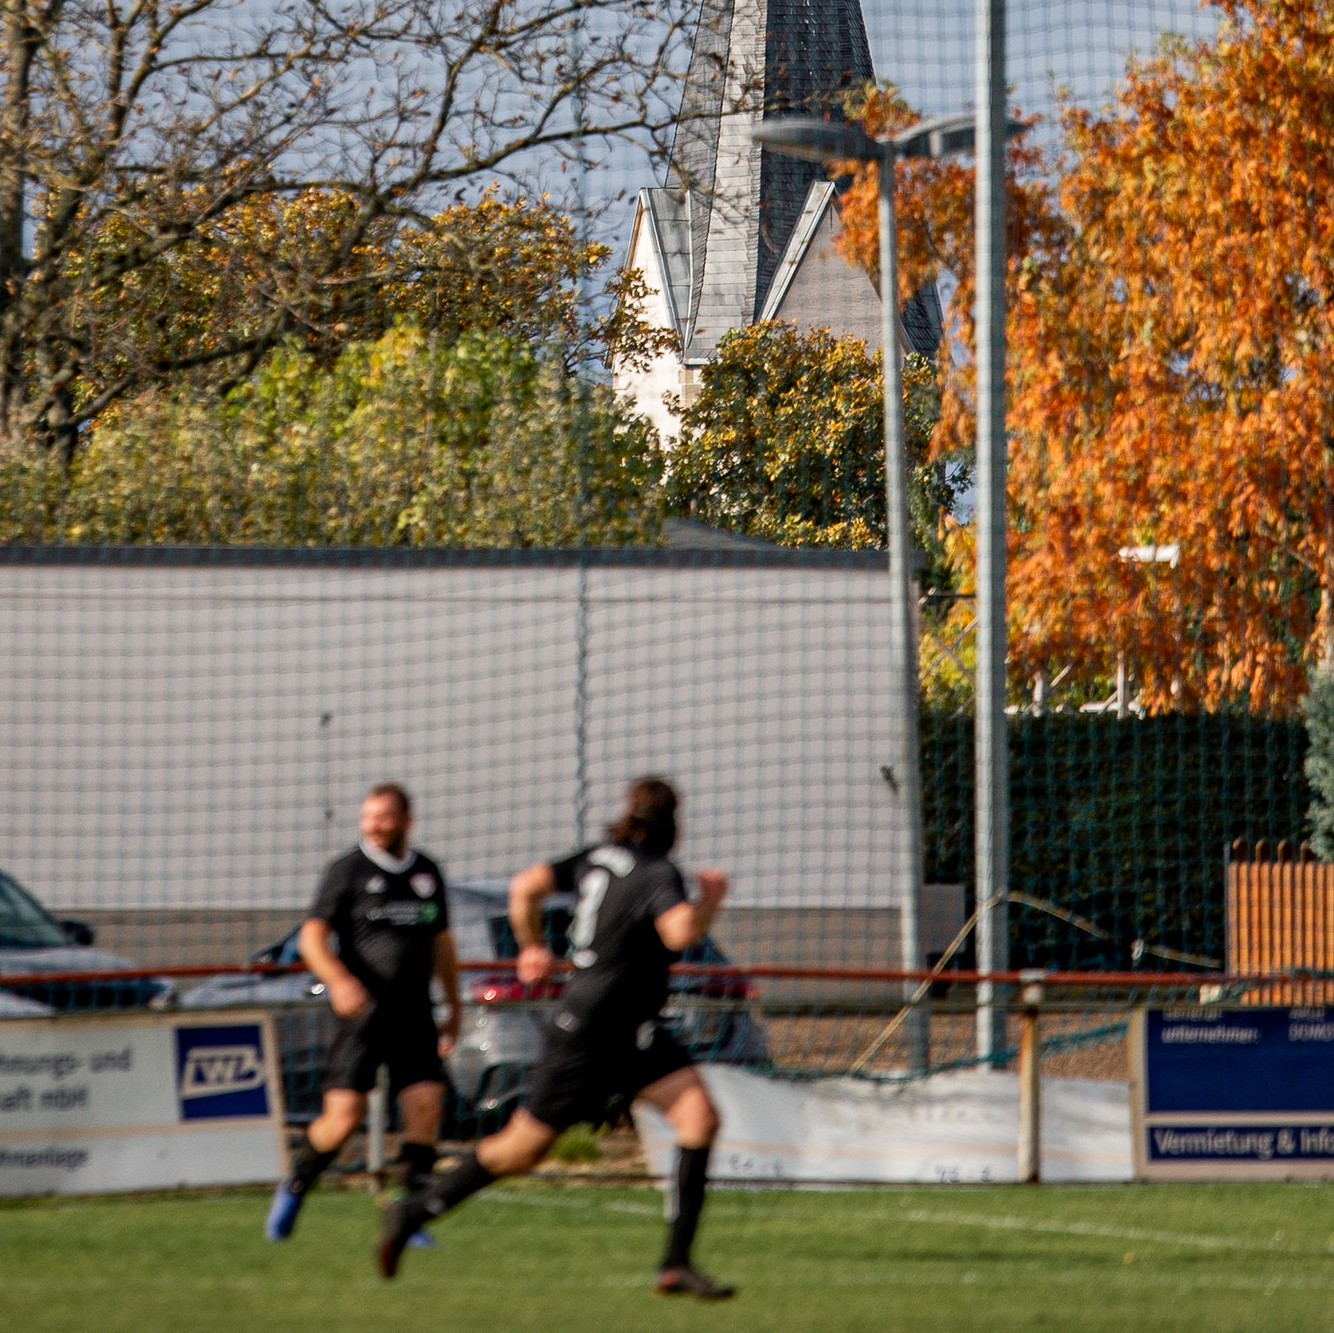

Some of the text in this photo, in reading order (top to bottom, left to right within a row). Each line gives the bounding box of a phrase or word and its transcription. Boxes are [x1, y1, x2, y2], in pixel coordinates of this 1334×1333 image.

[89, 1046, 133, 1073] und
[1153, 1129, 1274, 1159] Vermietung
[1277, 1129, 1297, 1155] &
